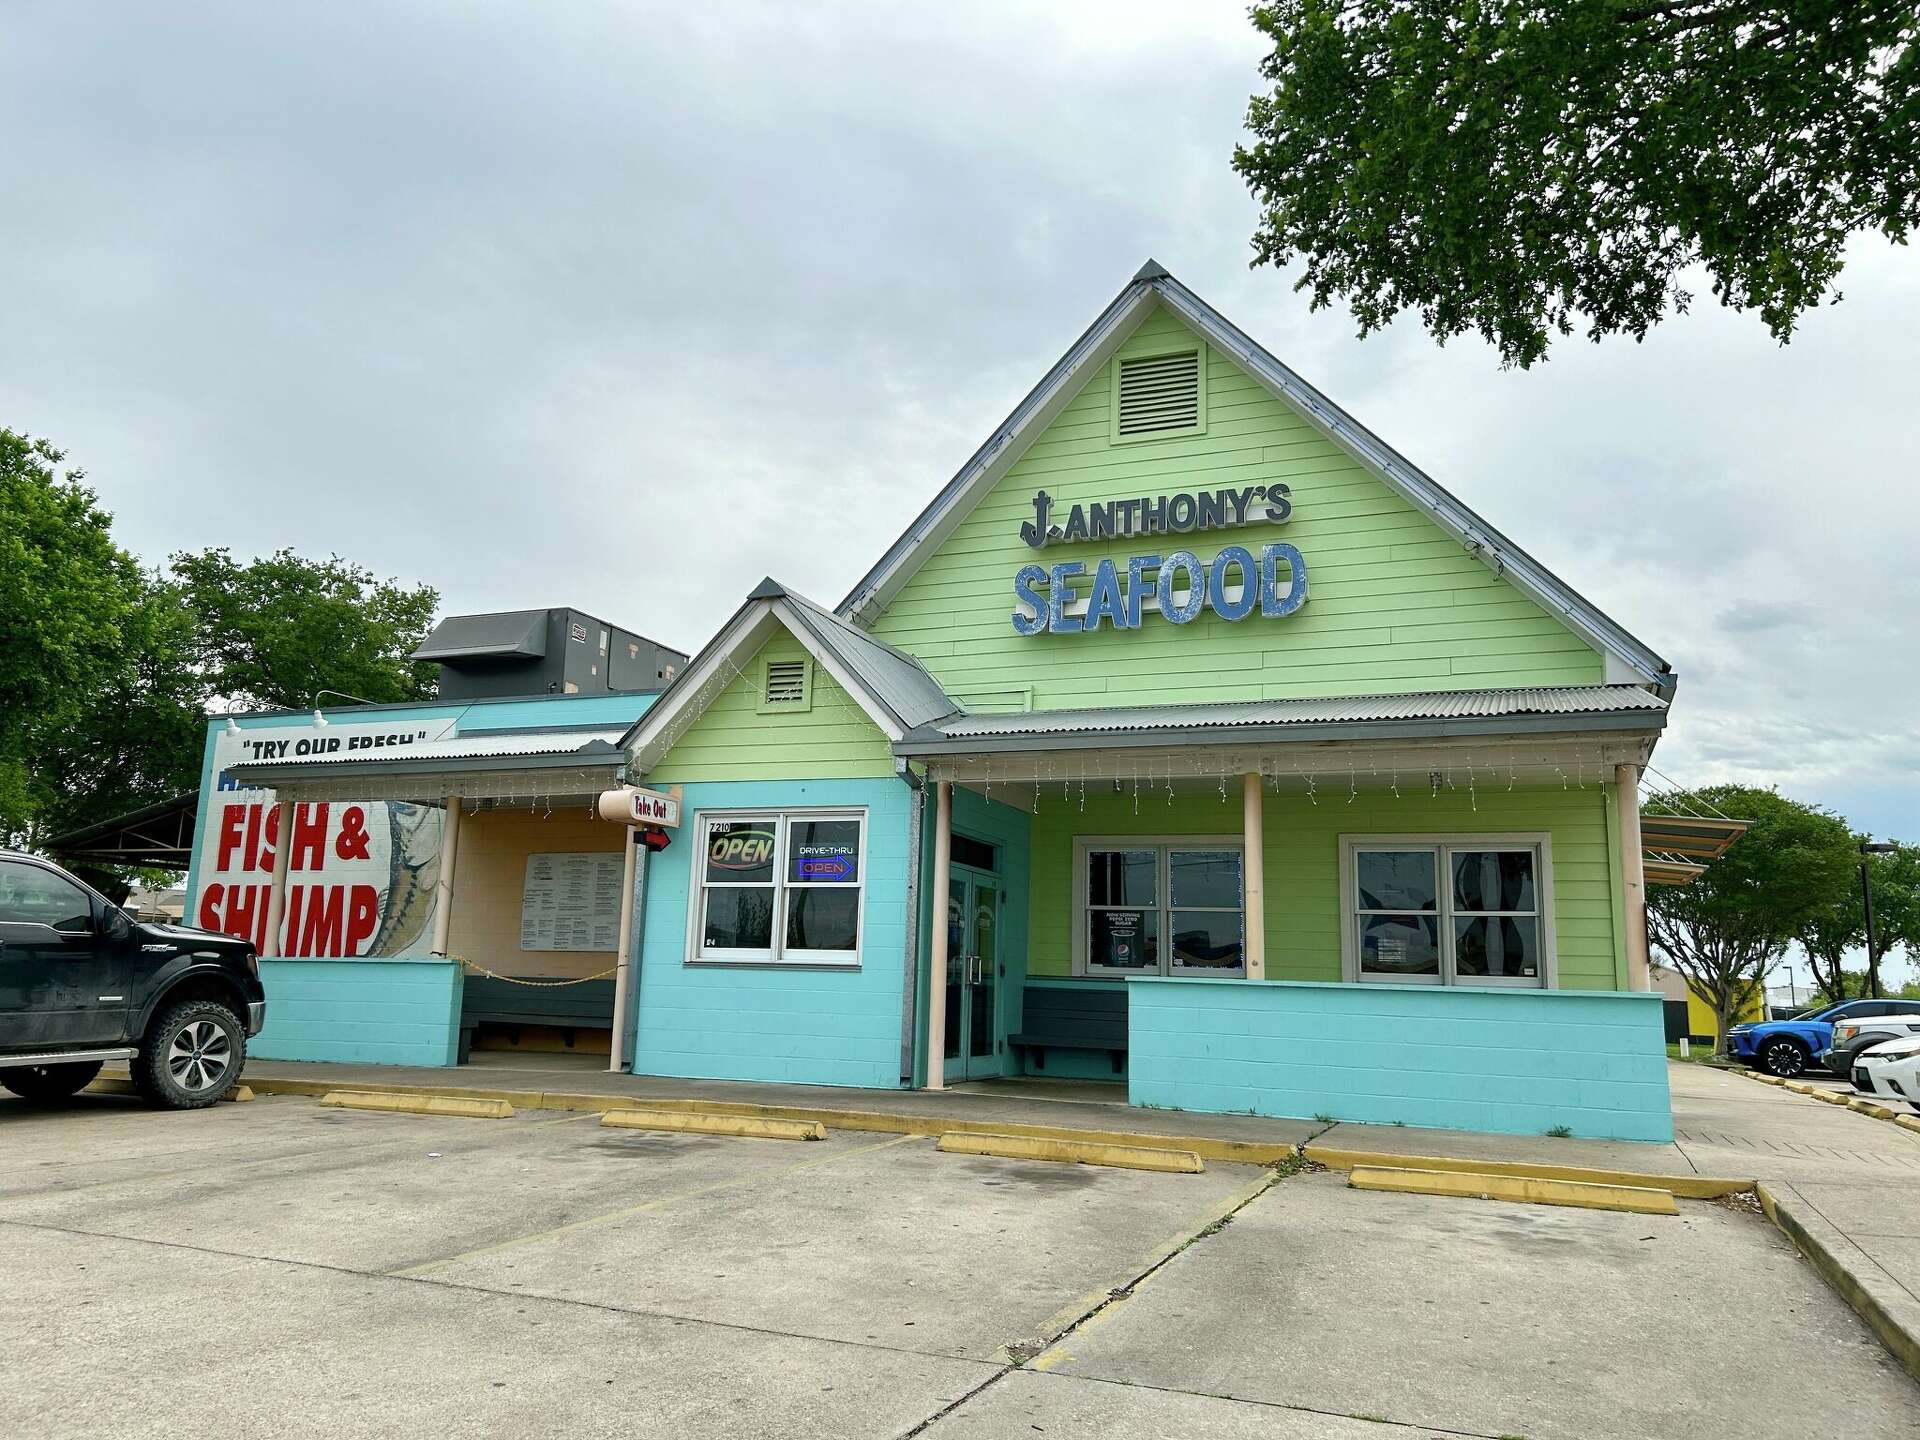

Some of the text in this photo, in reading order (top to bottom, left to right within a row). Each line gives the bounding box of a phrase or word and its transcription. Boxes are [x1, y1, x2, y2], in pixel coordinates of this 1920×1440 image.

[1011, 543, 1308, 636] SEAFOOD
[295, 737, 340, 756] OUR
[635, 795, 667, 819] Take Out
[335, 806, 371, 860] &
[710, 822, 730, 833] 7210
[711, 837, 772, 862] OPEN
[800, 846, 853, 855] DRIVE-THRU
[803, 863, 843, 873] OPEN
